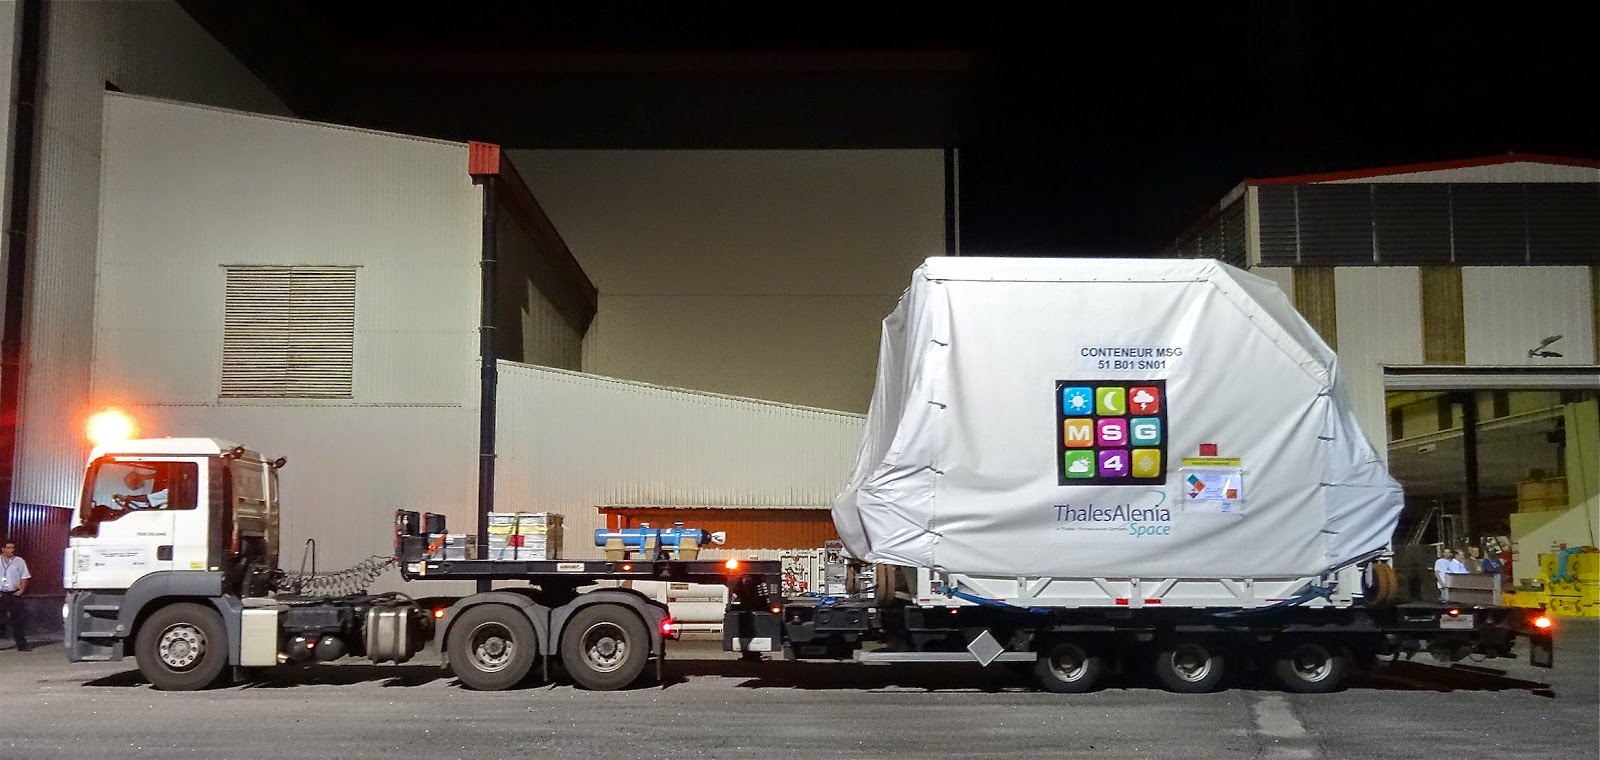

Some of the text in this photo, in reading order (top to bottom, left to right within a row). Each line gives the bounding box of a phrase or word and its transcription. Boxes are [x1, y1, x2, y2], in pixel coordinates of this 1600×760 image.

[1080, 347, 1183, 358] CONTENEUR MSG
[1098, 360, 1166, 369] 51 B01 SN01
[1103, 455, 1123, 471] 4
[1054, 503, 1171, 522] ThalesAlenia
[1129, 522, 1171, 538] Space
